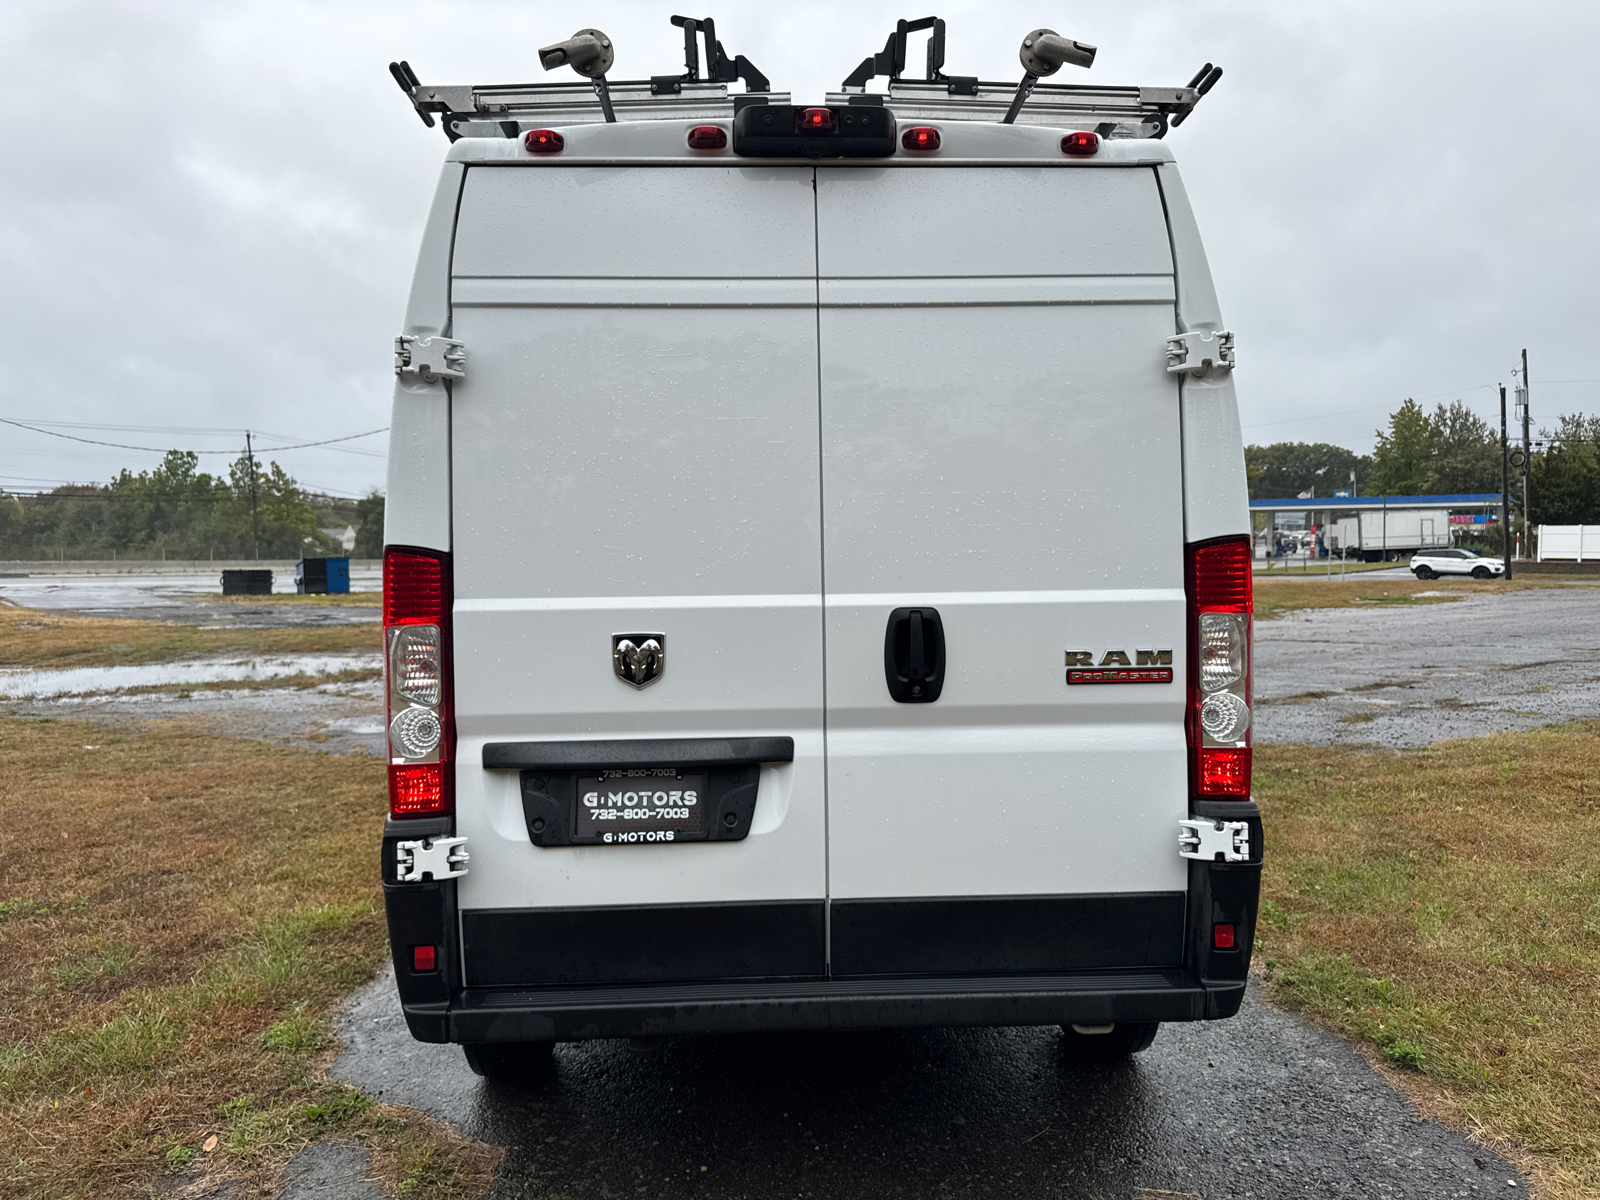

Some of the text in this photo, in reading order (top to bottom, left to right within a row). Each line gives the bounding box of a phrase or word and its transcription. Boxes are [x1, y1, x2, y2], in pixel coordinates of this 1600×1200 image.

[1065, 649, 1172, 666] RAM
[1071, 671, 1169, 680] PROMASTER
[602, 769, 676, 778] 732-800-7003
[590, 808, 689, 820] 732-800-7003
